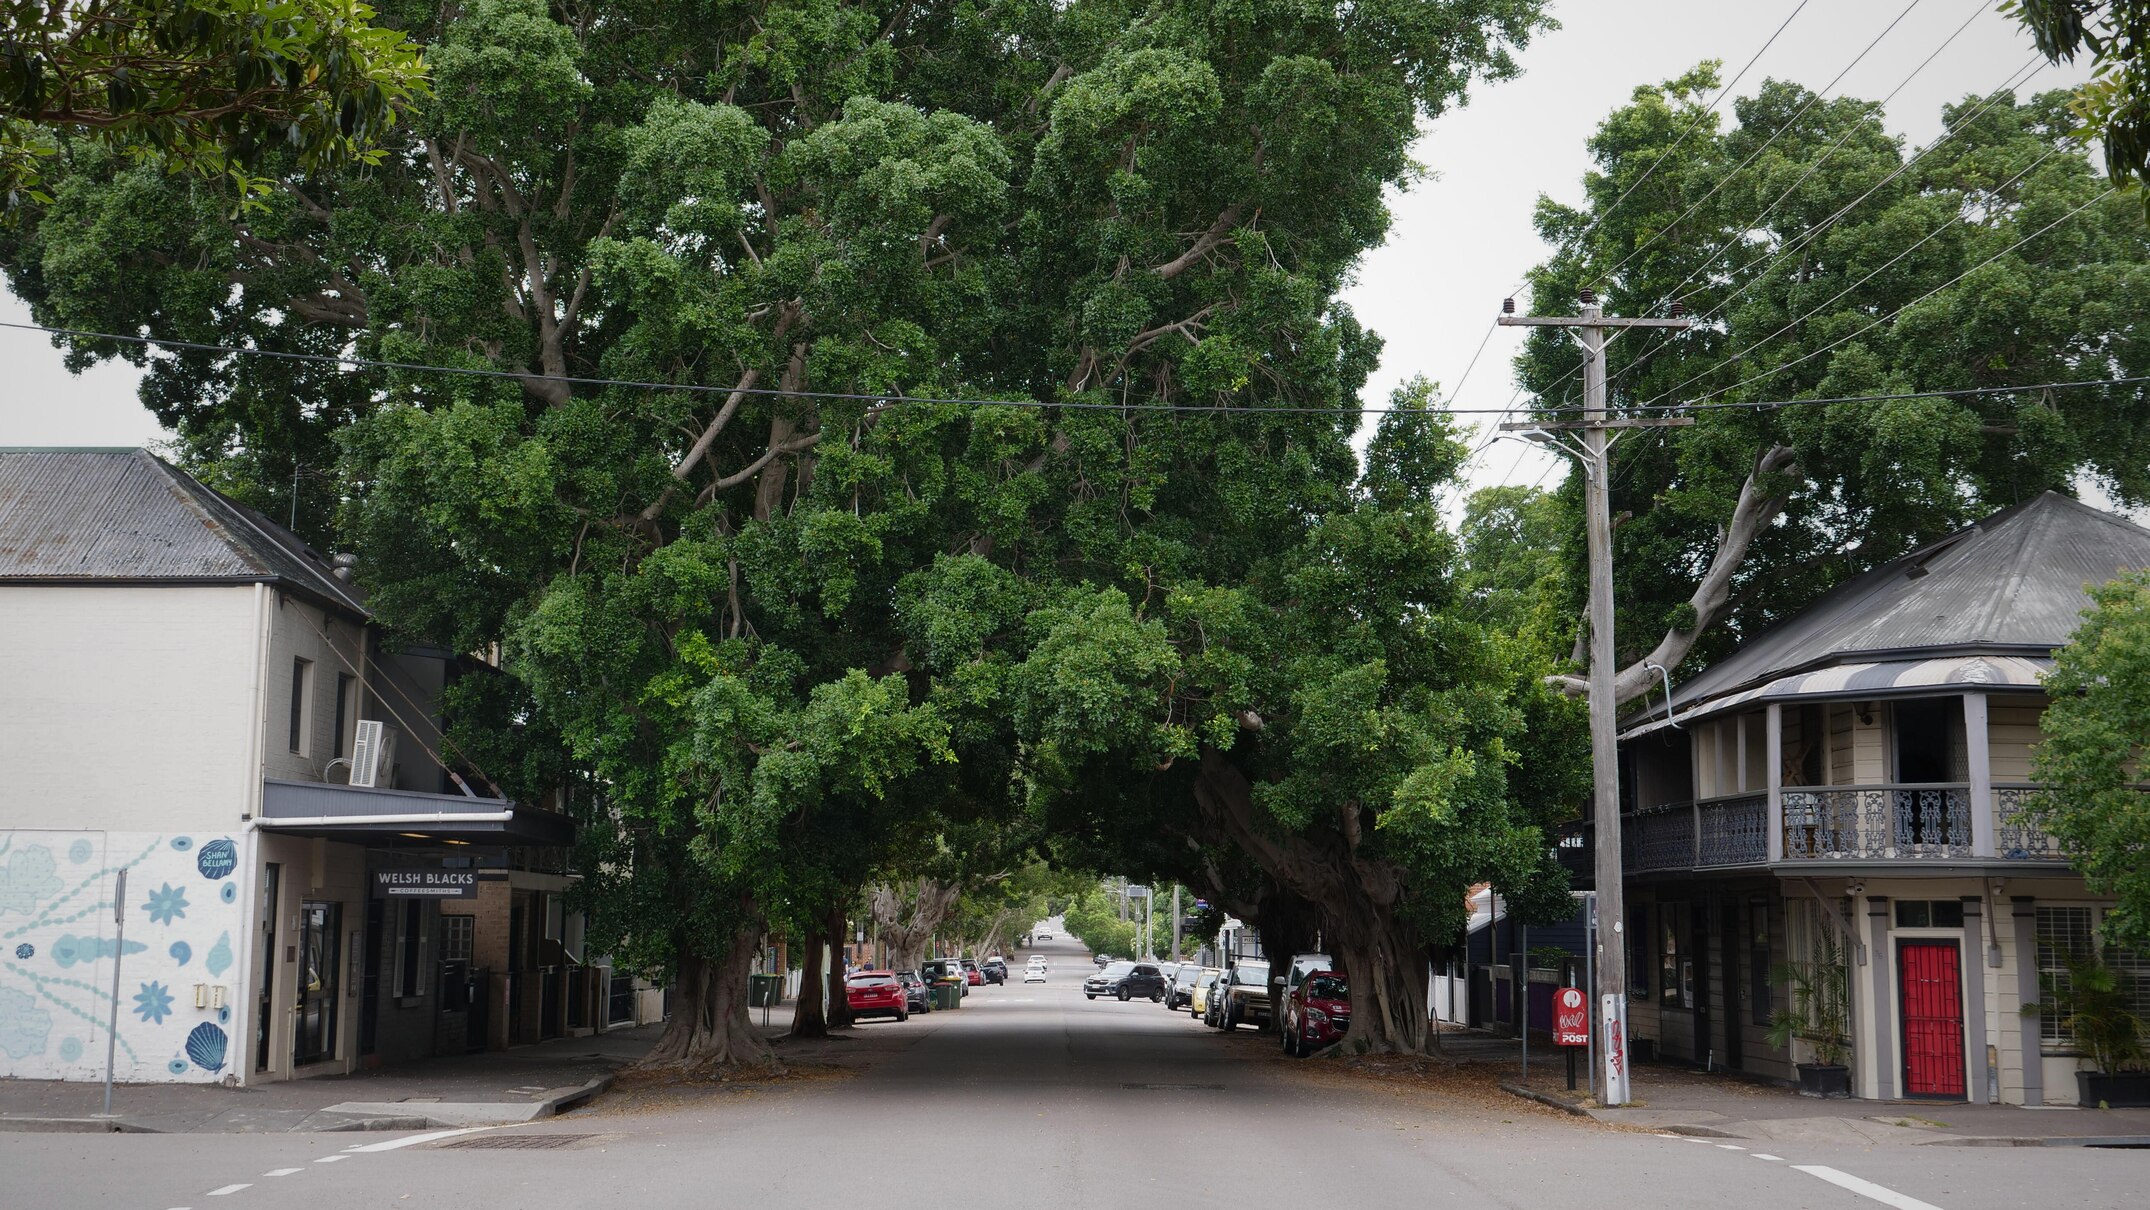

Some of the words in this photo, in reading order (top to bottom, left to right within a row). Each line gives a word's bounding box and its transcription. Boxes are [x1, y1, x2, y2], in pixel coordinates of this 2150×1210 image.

[206, 851, 228, 859] SHAN
[202, 859, 232, 867] BELLAMY
[379, 873, 421, 884] WELSH
[426, 873, 474, 884] BLACKS
[1562, 1035, 1588, 1043] POST
